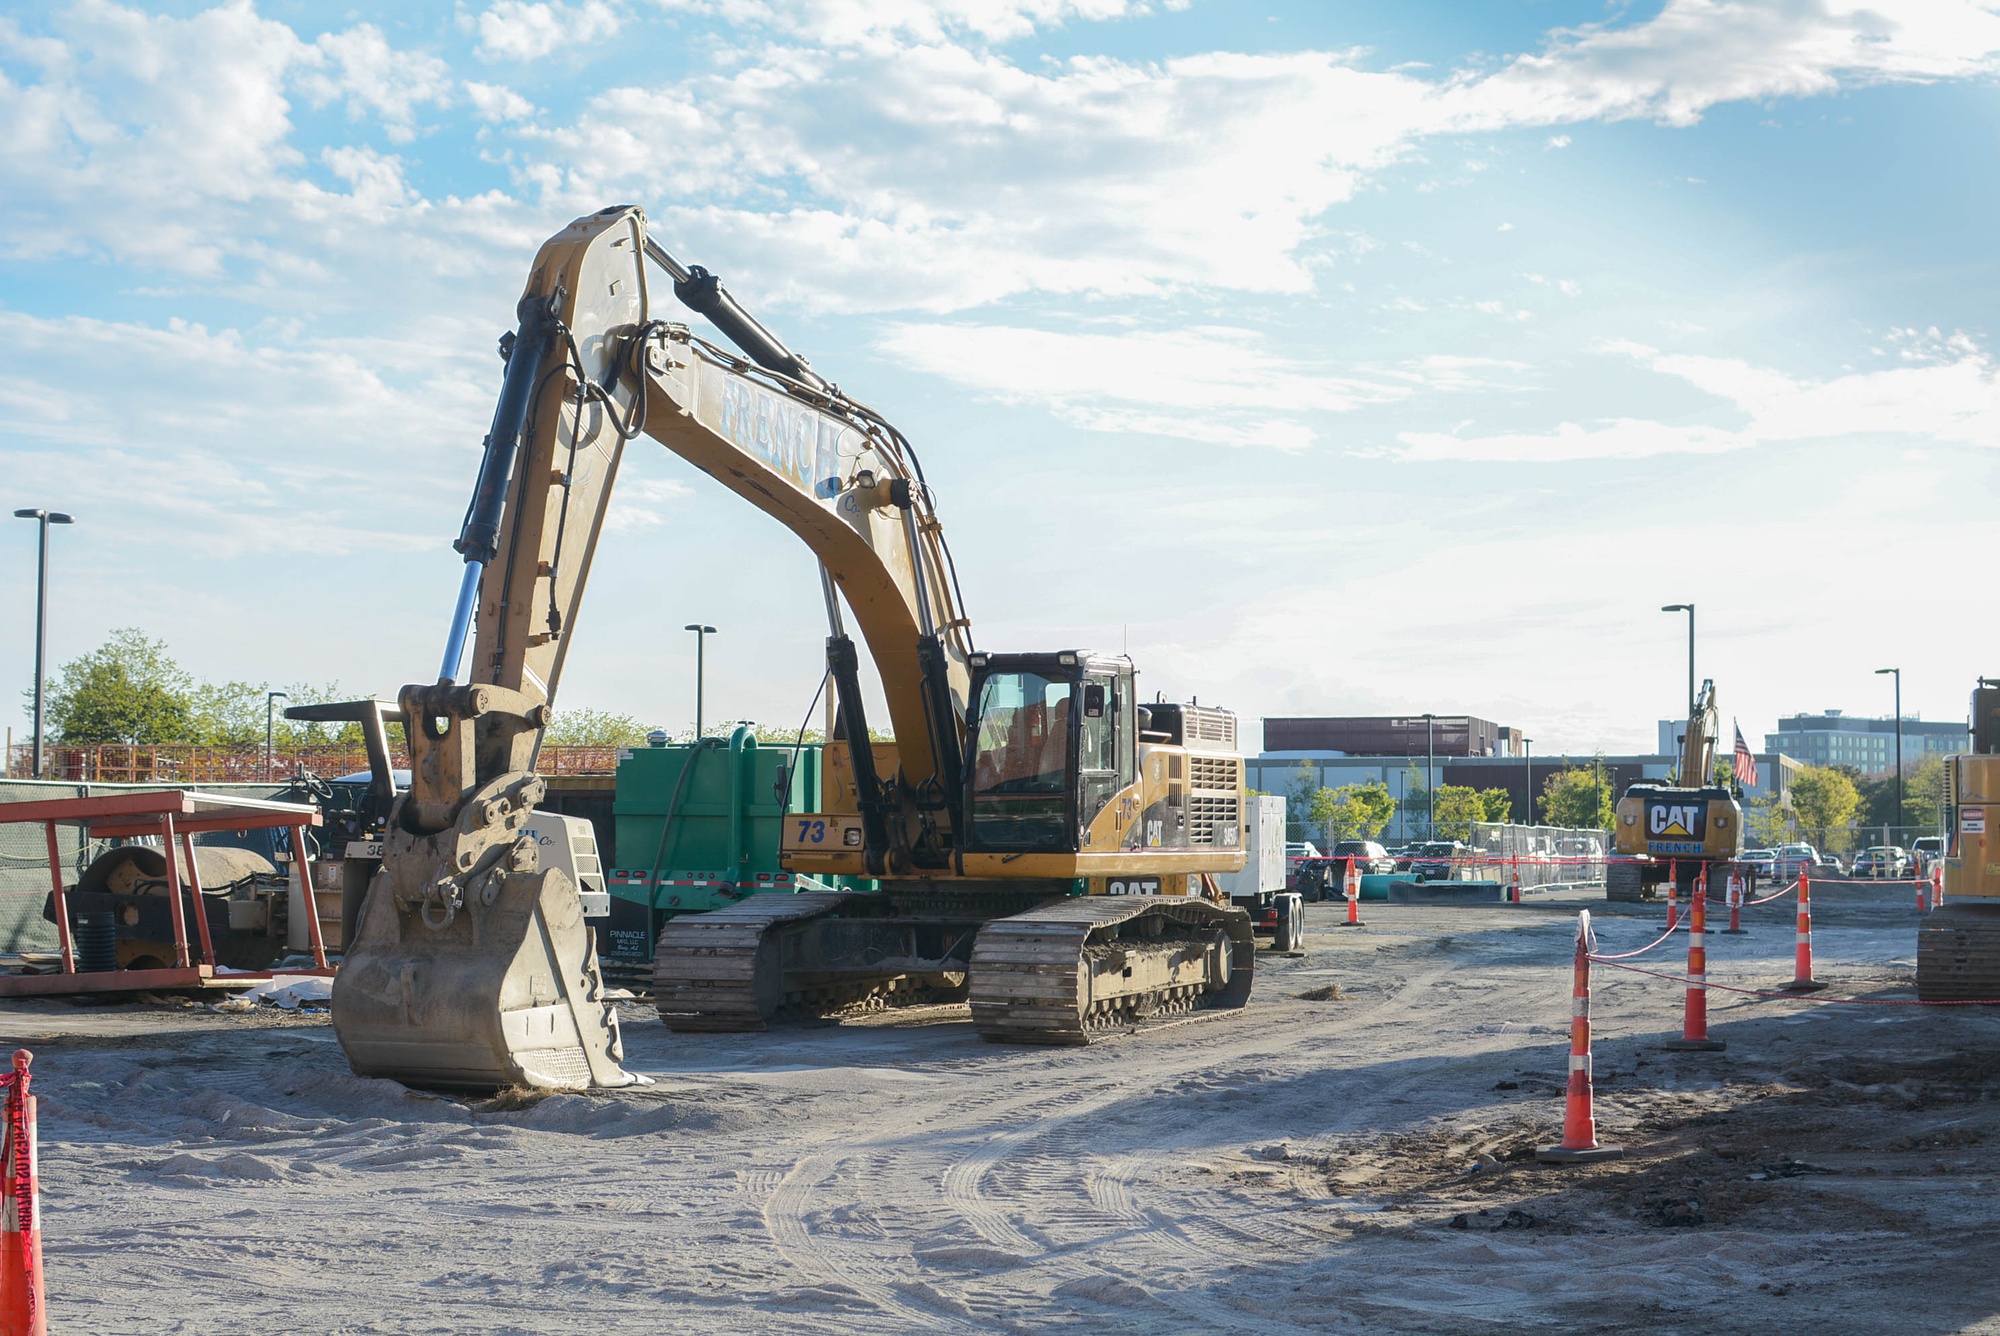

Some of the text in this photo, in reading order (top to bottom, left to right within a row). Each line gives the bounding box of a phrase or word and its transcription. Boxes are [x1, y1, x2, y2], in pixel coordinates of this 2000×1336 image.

[720, 376, 841, 499] FRENCH
[844, 495, 860, 518] Co.
[1121, 797, 1133, 820] 73
[798, 820, 825, 843] 73
[1650, 805, 1699, 836] CAT
[1147, 820, 1163, 847] CAT
[1648, 841, 1703, 854] FRENCH
[610, 930, 646, 939] PINNACLE
